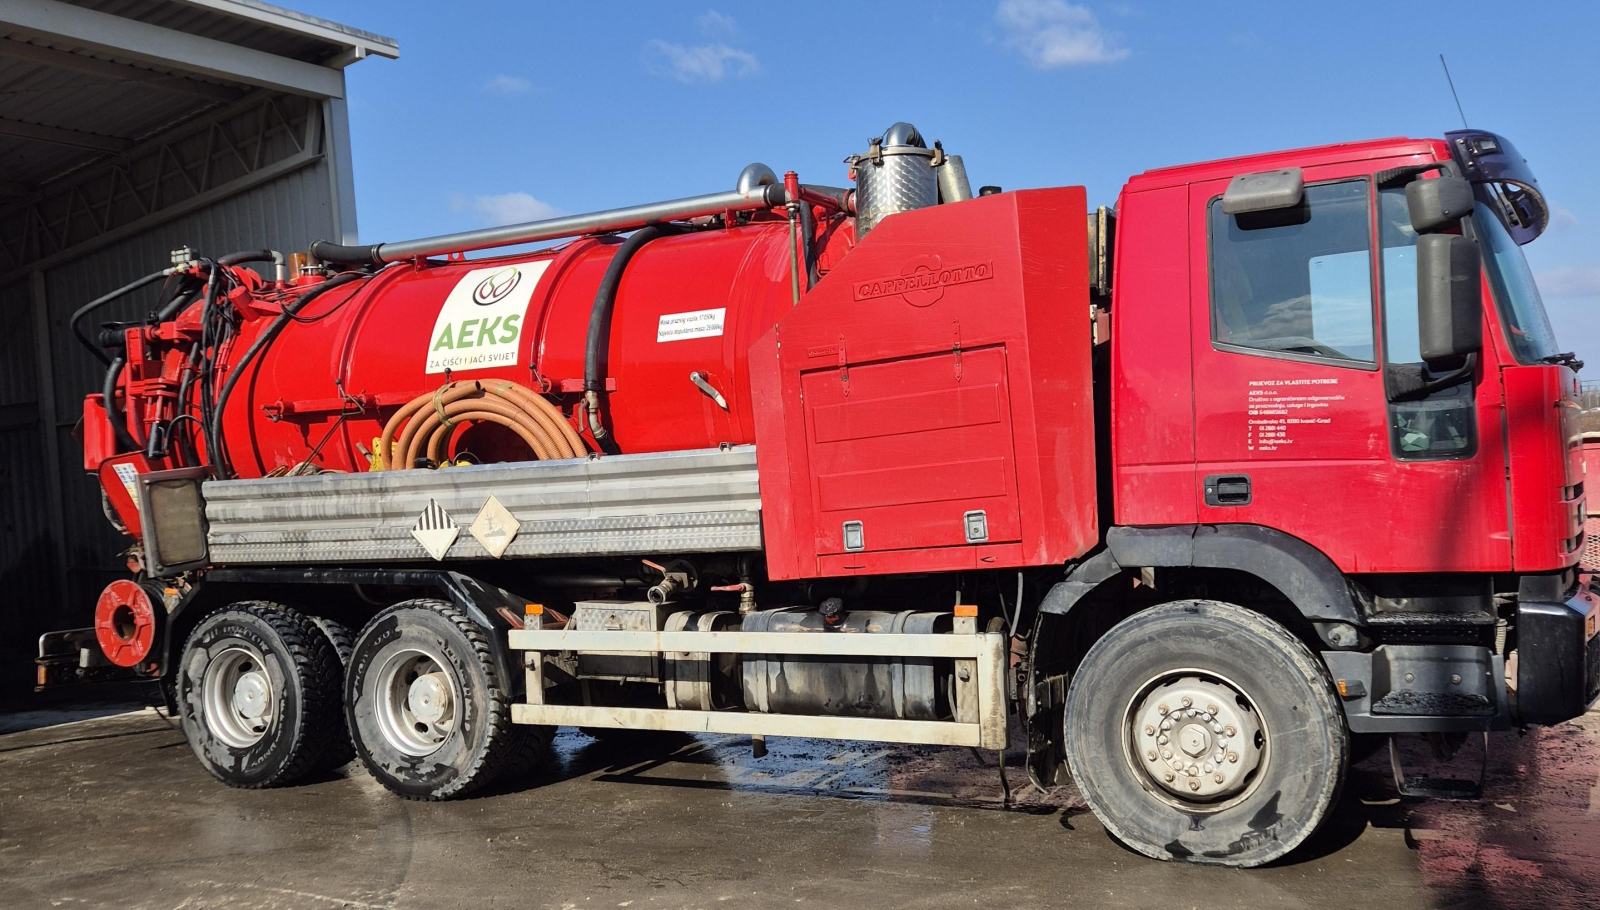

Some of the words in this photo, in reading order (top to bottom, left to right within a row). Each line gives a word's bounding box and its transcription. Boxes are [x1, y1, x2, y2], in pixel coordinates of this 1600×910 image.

[858, 264, 988, 296] CAPPELLOTTO
[432, 314, 520, 352] AEKS
[430, 360, 440, 368] ZA
[488, 352, 515, 362] SVIJET
